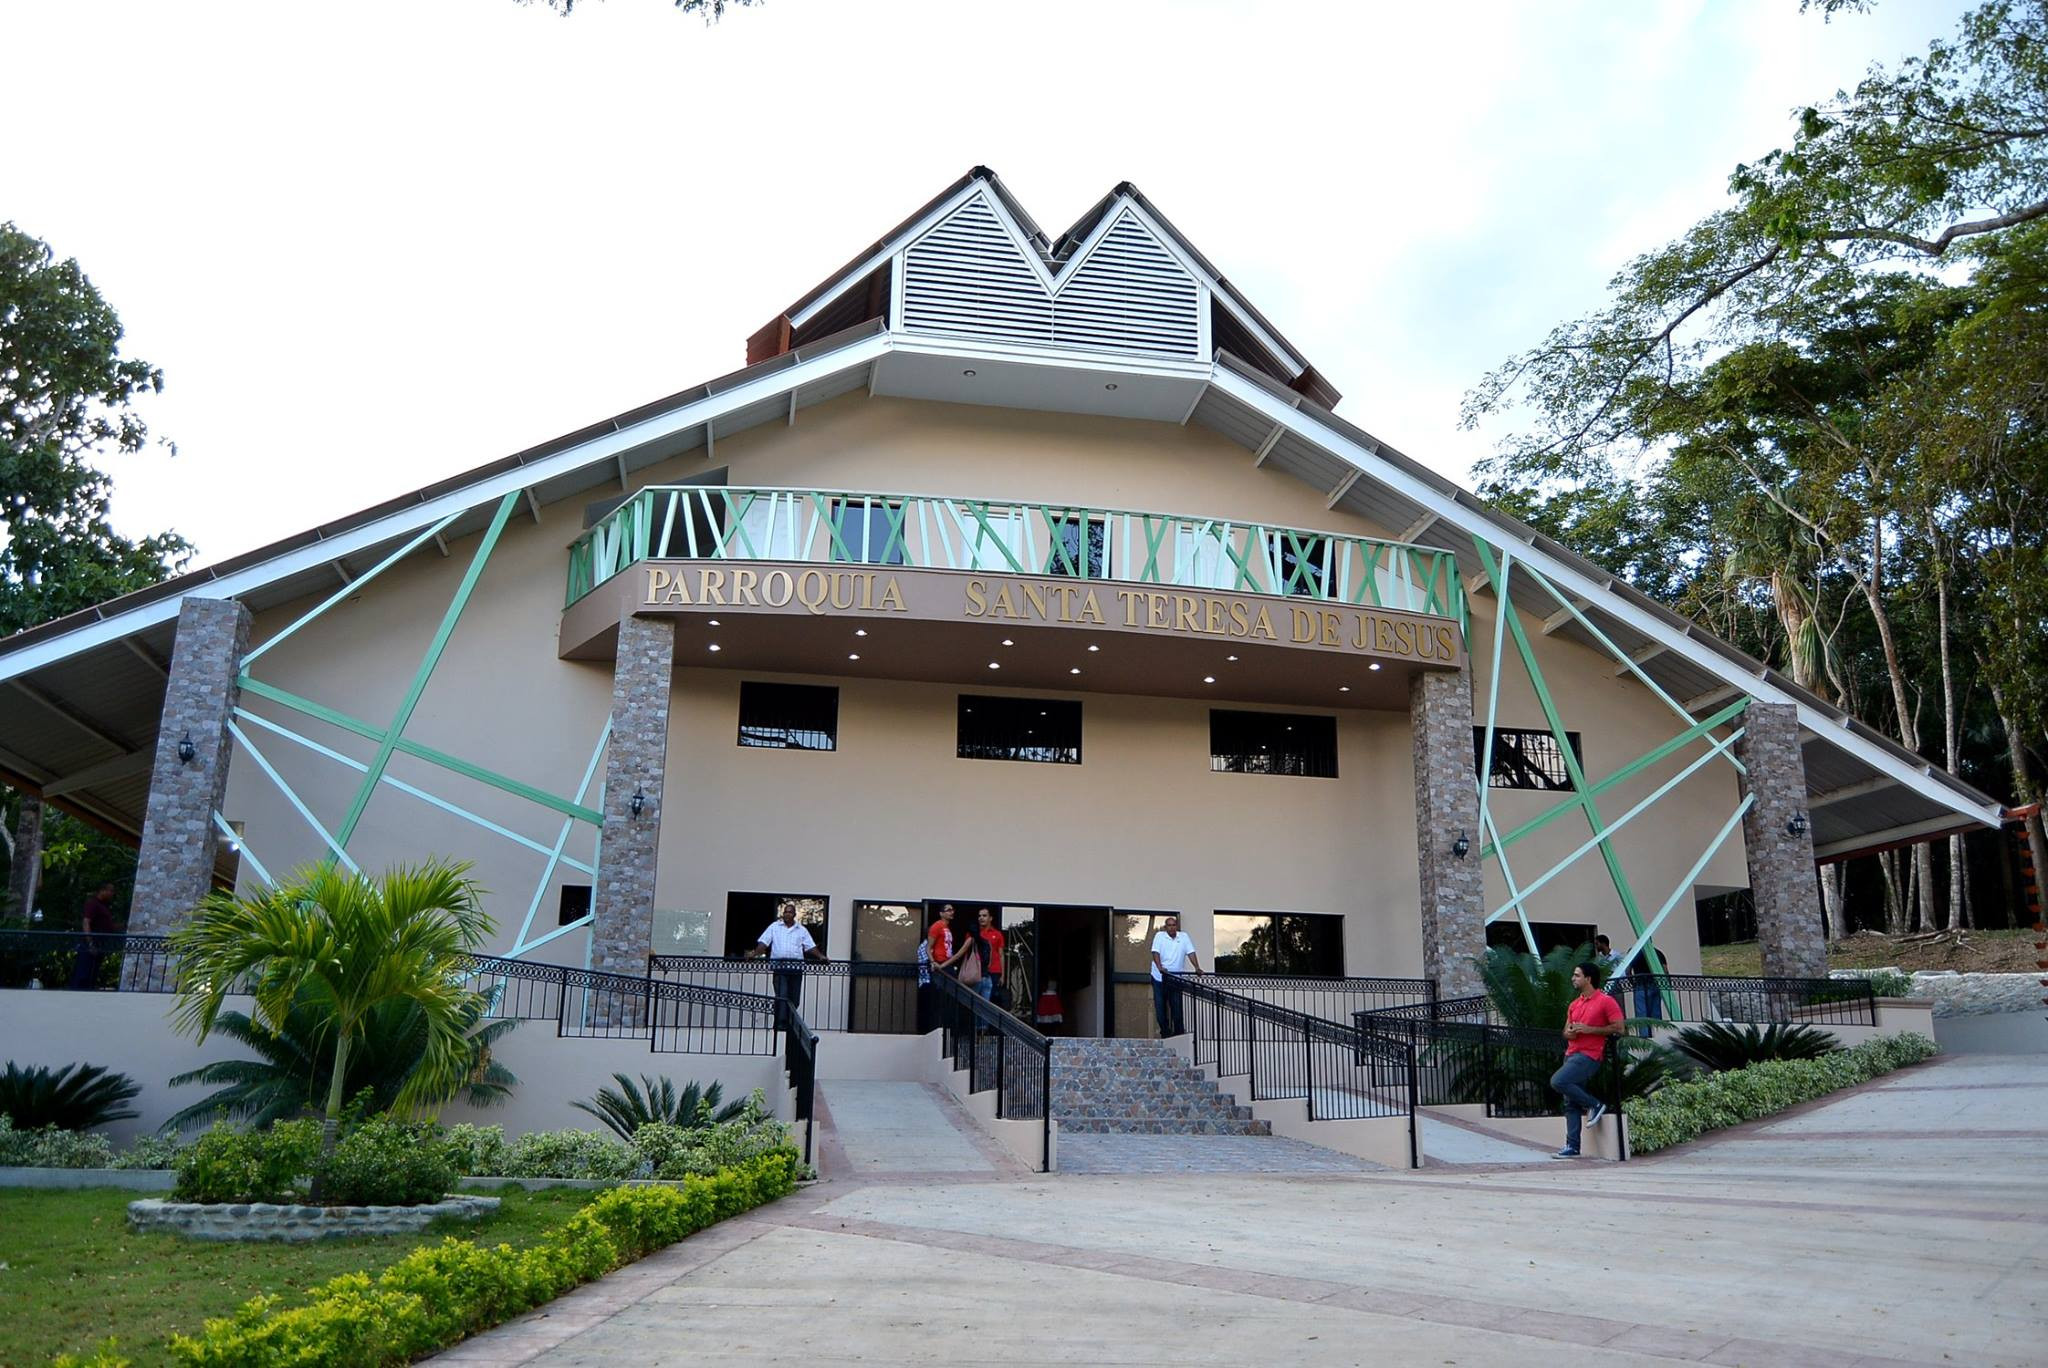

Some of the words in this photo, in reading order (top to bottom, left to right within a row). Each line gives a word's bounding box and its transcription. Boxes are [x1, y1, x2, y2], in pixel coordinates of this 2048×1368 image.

[644, 568, 908, 615] PARROQUIA
[964, 580, 1106, 624] SANTA
[1117, 590, 1278, 640] TERESA
[1292, 608, 1342, 647] DE
[1352, 614, 1457, 661] JESUS
